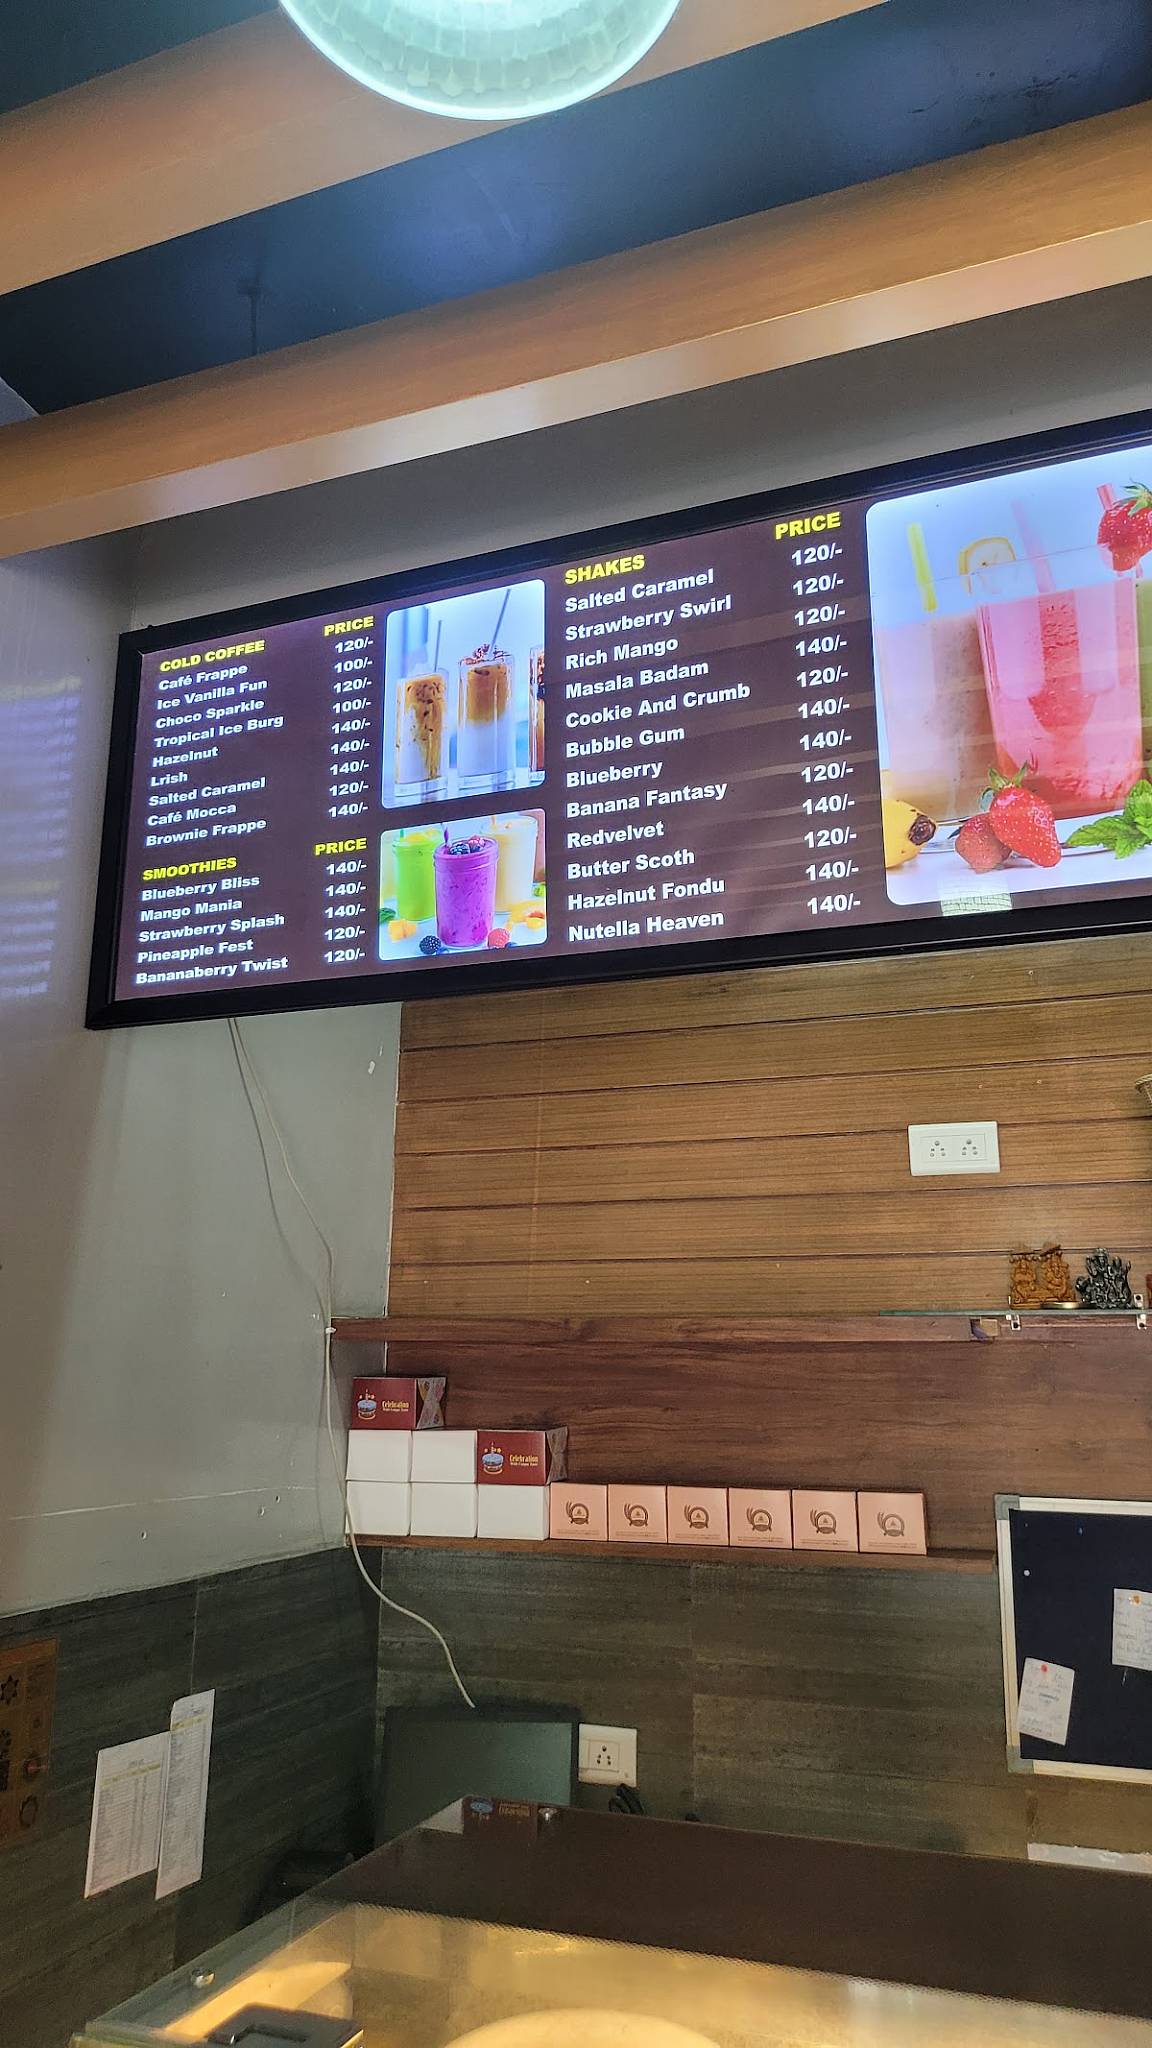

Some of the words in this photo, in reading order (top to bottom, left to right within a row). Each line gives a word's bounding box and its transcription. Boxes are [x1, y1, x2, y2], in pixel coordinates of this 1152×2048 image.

[776, 512, 840, 539] PRICE
[792, 543, 842, 565] 120/-
[565, 555, 645, 584] SHAKES
[565, 587, 625, 612] Salted
[632, 568, 715, 601] Caramel
[793, 573, 843, 595] 120/-
[324, 616, 373, 636] PRICE
[566, 610, 674, 640] Strawberry
[680, 594, 731, 618] Swirl
[795, 604, 845, 626] 120/-
[160, 655, 201, 671] COLD
[205, 640, 265, 662] COFFEE
[335, 637, 373, 653] 120/-
[566, 650, 607, 670] Rich
[614, 639, 678, 661] Mango
[796, 635, 847, 656] 140/-
[334, 657, 372, 673] 100/-
[797, 665, 848, 687] 120/-
[159, 675, 192, 690] Café
[196, 666, 247, 683] Frappe
[334, 677, 371, 693] 120/-
[566, 675, 633, 699] Masala
[640, 663, 708, 685] Badam
[157, 699, 180, 709] Ice
[184, 687, 234, 703] Vanilla
[240, 681, 267, 693] Fun
[333, 698, 371, 713] 100/-
[566, 705, 632, 727] Cookie
[638, 695, 676, 715] And
[683, 683, 750, 707] Crumb
[156, 713, 201, 728] Choco
[206, 700, 264, 719] Sparkle
[798, 697, 850, 718] 140/-
[154, 728, 214, 747] Tropical
[219, 725, 242, 735] Ice
[248, 717, 283, 730] Burg
[332, 718, 370, 734] 140/-
[331, 739, 369, 754] 140/-
[567, 735, 633, 758] Bubble
[639, 728, 684, 745] Gum
[800, 729, 851, 750] 140/-
[153, 747, 218, 767] Hazelnut
[330, 760, 369, 775] 140/-
[151, 772, 187, 786] Lrish
[567, 762, 662, 787] Blueberry
[801, 761, 853, 783] 120/-
[149, 788, 197, 806] Salted
[202, 777, 265, 797] Caramel
[330, 781, 368, 796] 120/-
[329, 802, 368, 817] 140/-
[567, 797, 639, 818] Banana
[647, 783, 727, 806] Fantasy
[802, 794, 855, 815] 140/-
[148, 811, 182, 826] Café
[186, 805, 236, 820] Mocca
[146, 829, 208, 846] Brownie
[213, 820, 266, 835] Frappe
[567, 821, 664, 848] Redvelvet
[804, 826, 856, 848] 120/-
[315, 838, 366, 855] PRICE
[143, 858, 236, 880] SMOOTHIES
[326, 860, 366, 875] 140/-
[568, 860, 630, 879] Butter
[635, 849, 694, 870] Scoth
[806, 860, 859, 881] 140/-
[142, 883, 217, 901] Blueberry
[221, 877, 259, 890] Bliss
[325, 882, 366, 896] 140/-
[568, 885, 656, 910] Hazelnut
[662, 878, 724, 899] Fondu
[141, 908, 190, 921] Mango
[195, 899, 242, 914] Mania
[325, 904, 365, 918] 140/-
[807, 893, 860, 914] 140/-
[138, 924, 226, 942] Strawberry
[230, 914, 284, 932] Splash
[325, 926, 365, 940] 120/-
[569, 920, 640, 942] Nutella
[645, 913, 724, 933] Heaven
[138, 945, 214, 963] Pineapple
[219, 939, 253, 953] Fest
[324, 948, 365, 962] 120/-
[136, 965, 237, 984] Bananaberry
[241, 957, 288, 972] Twist
[510, 1454, 538, 1462] Celebration
